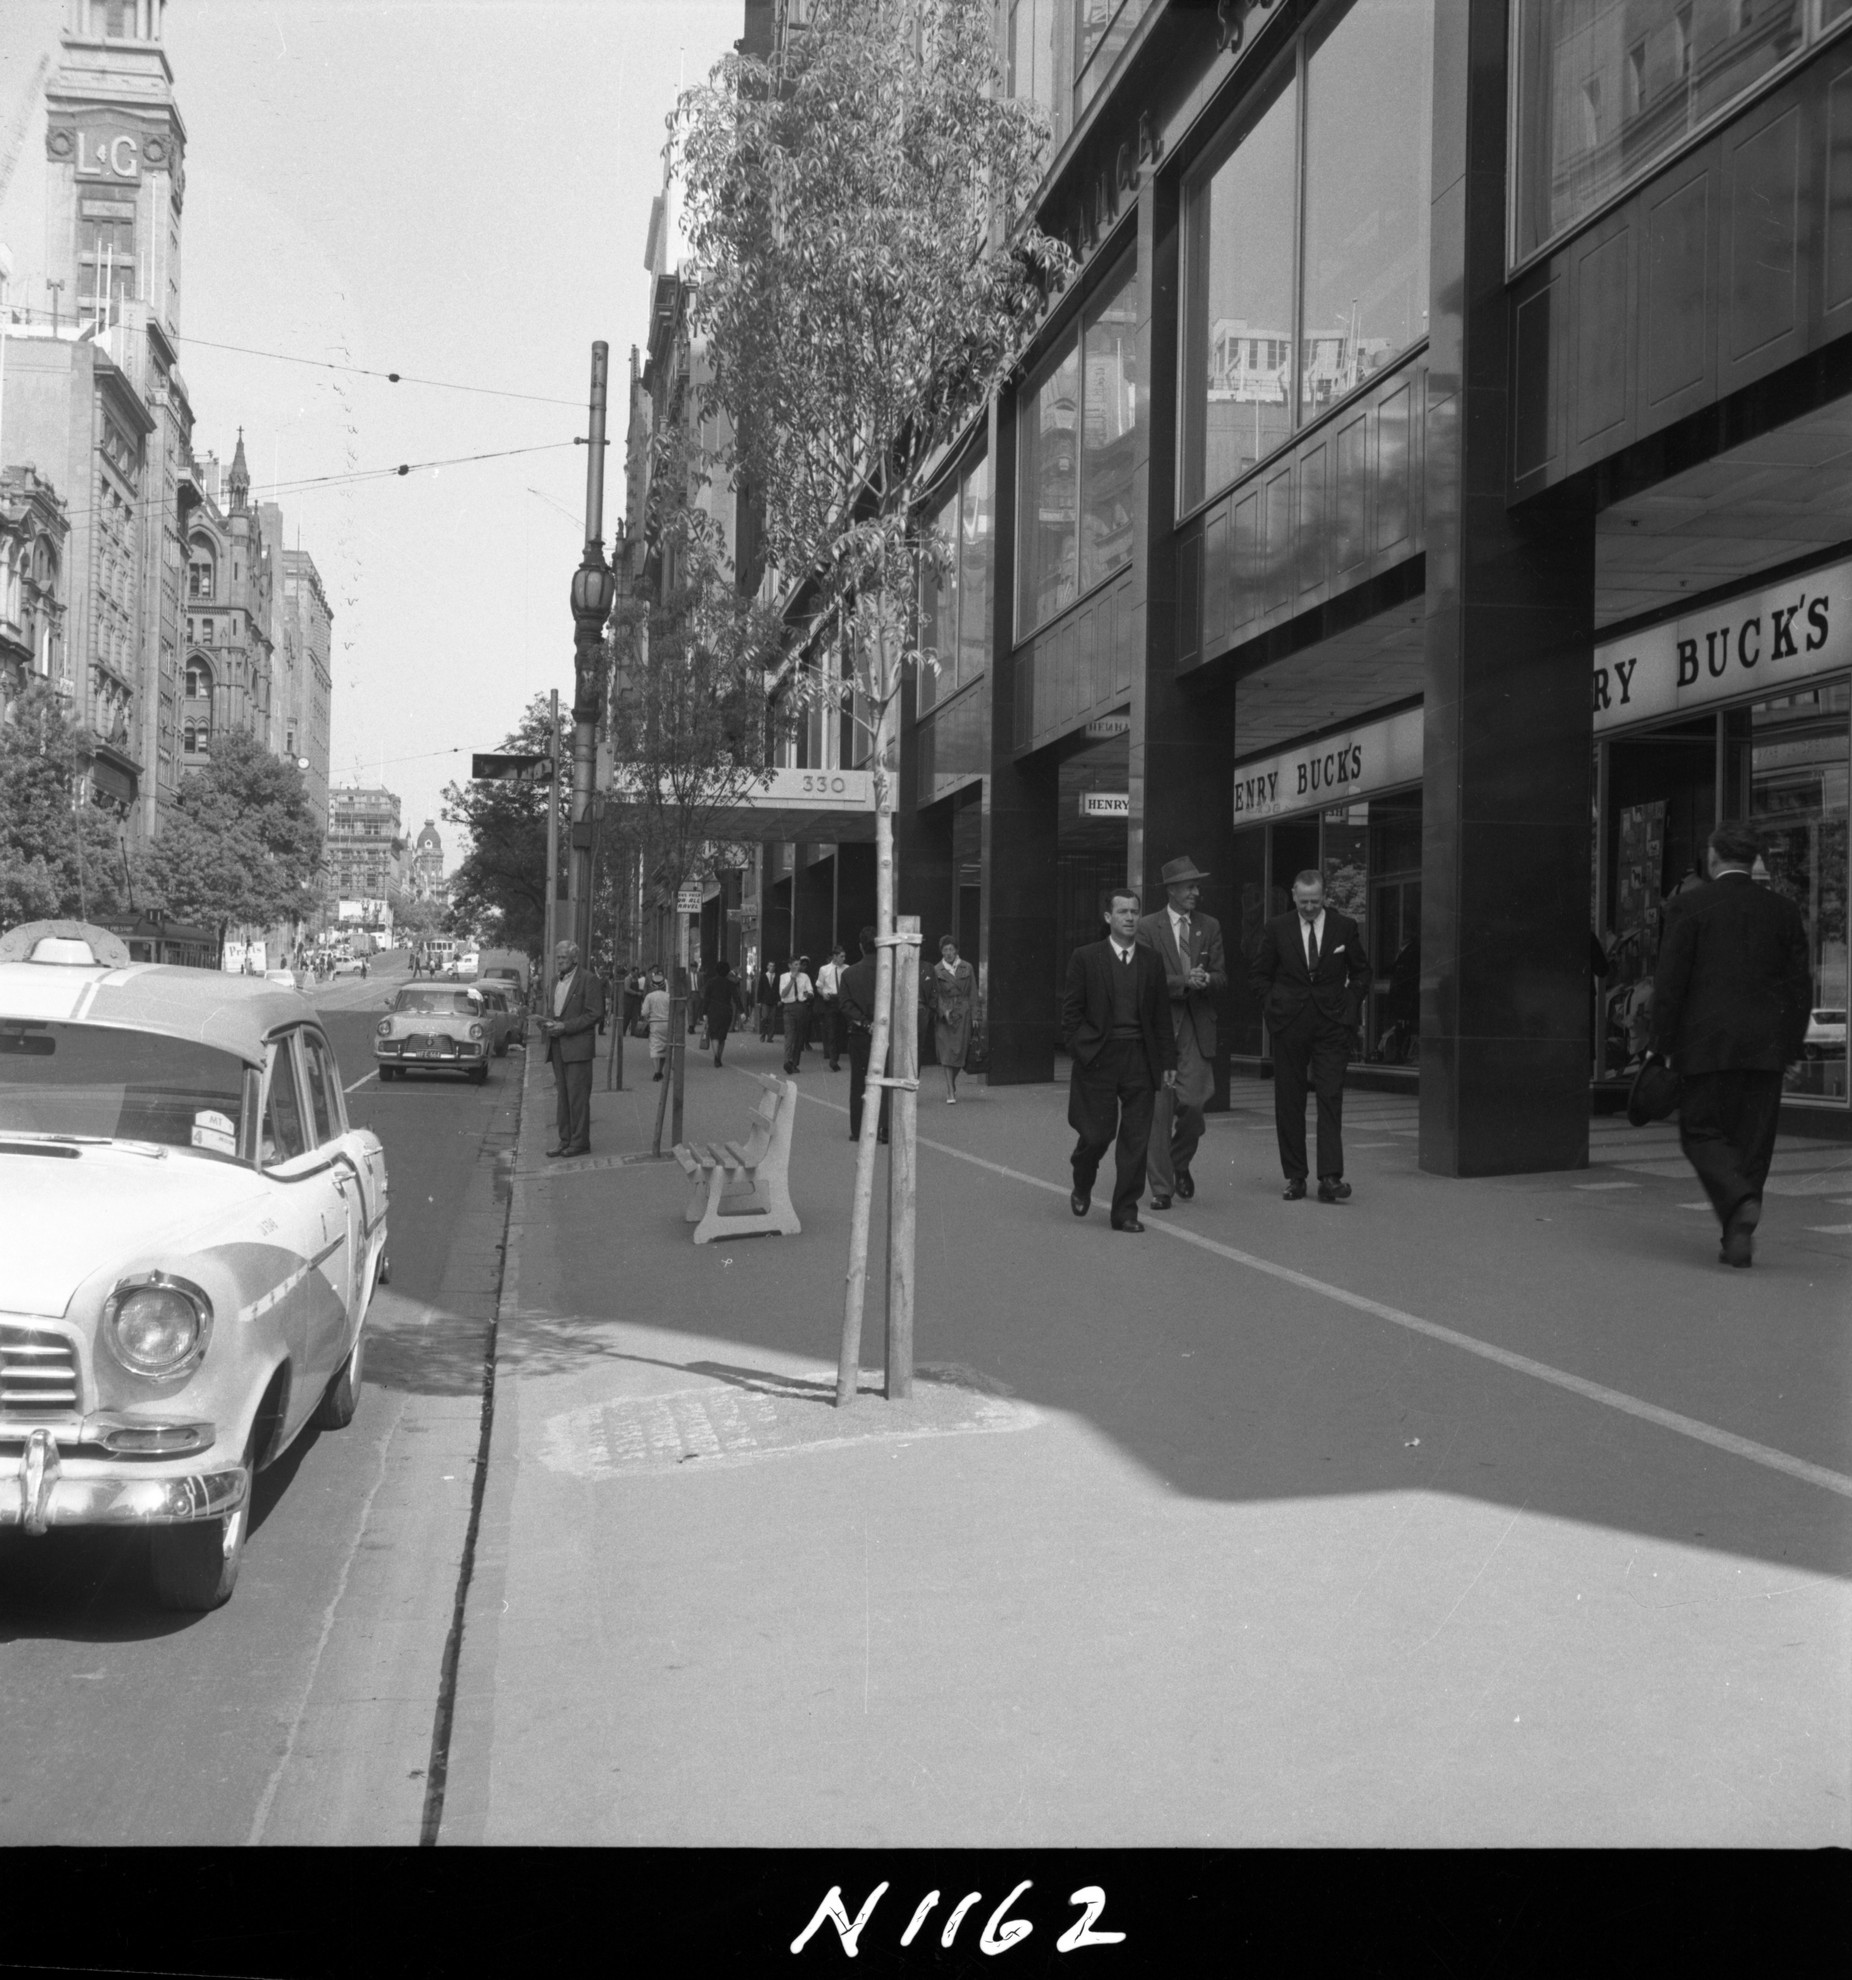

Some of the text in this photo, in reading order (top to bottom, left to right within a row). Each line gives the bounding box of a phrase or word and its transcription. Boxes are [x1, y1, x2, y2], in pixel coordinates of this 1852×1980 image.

[1593, 593, 1830, 712] RY BUCK'S
[802, 775, 846, 794] 330
[1235, 741, 1363, 812] ENRY BUCK'S
[1088, 799, 1130, 810] HENRY
